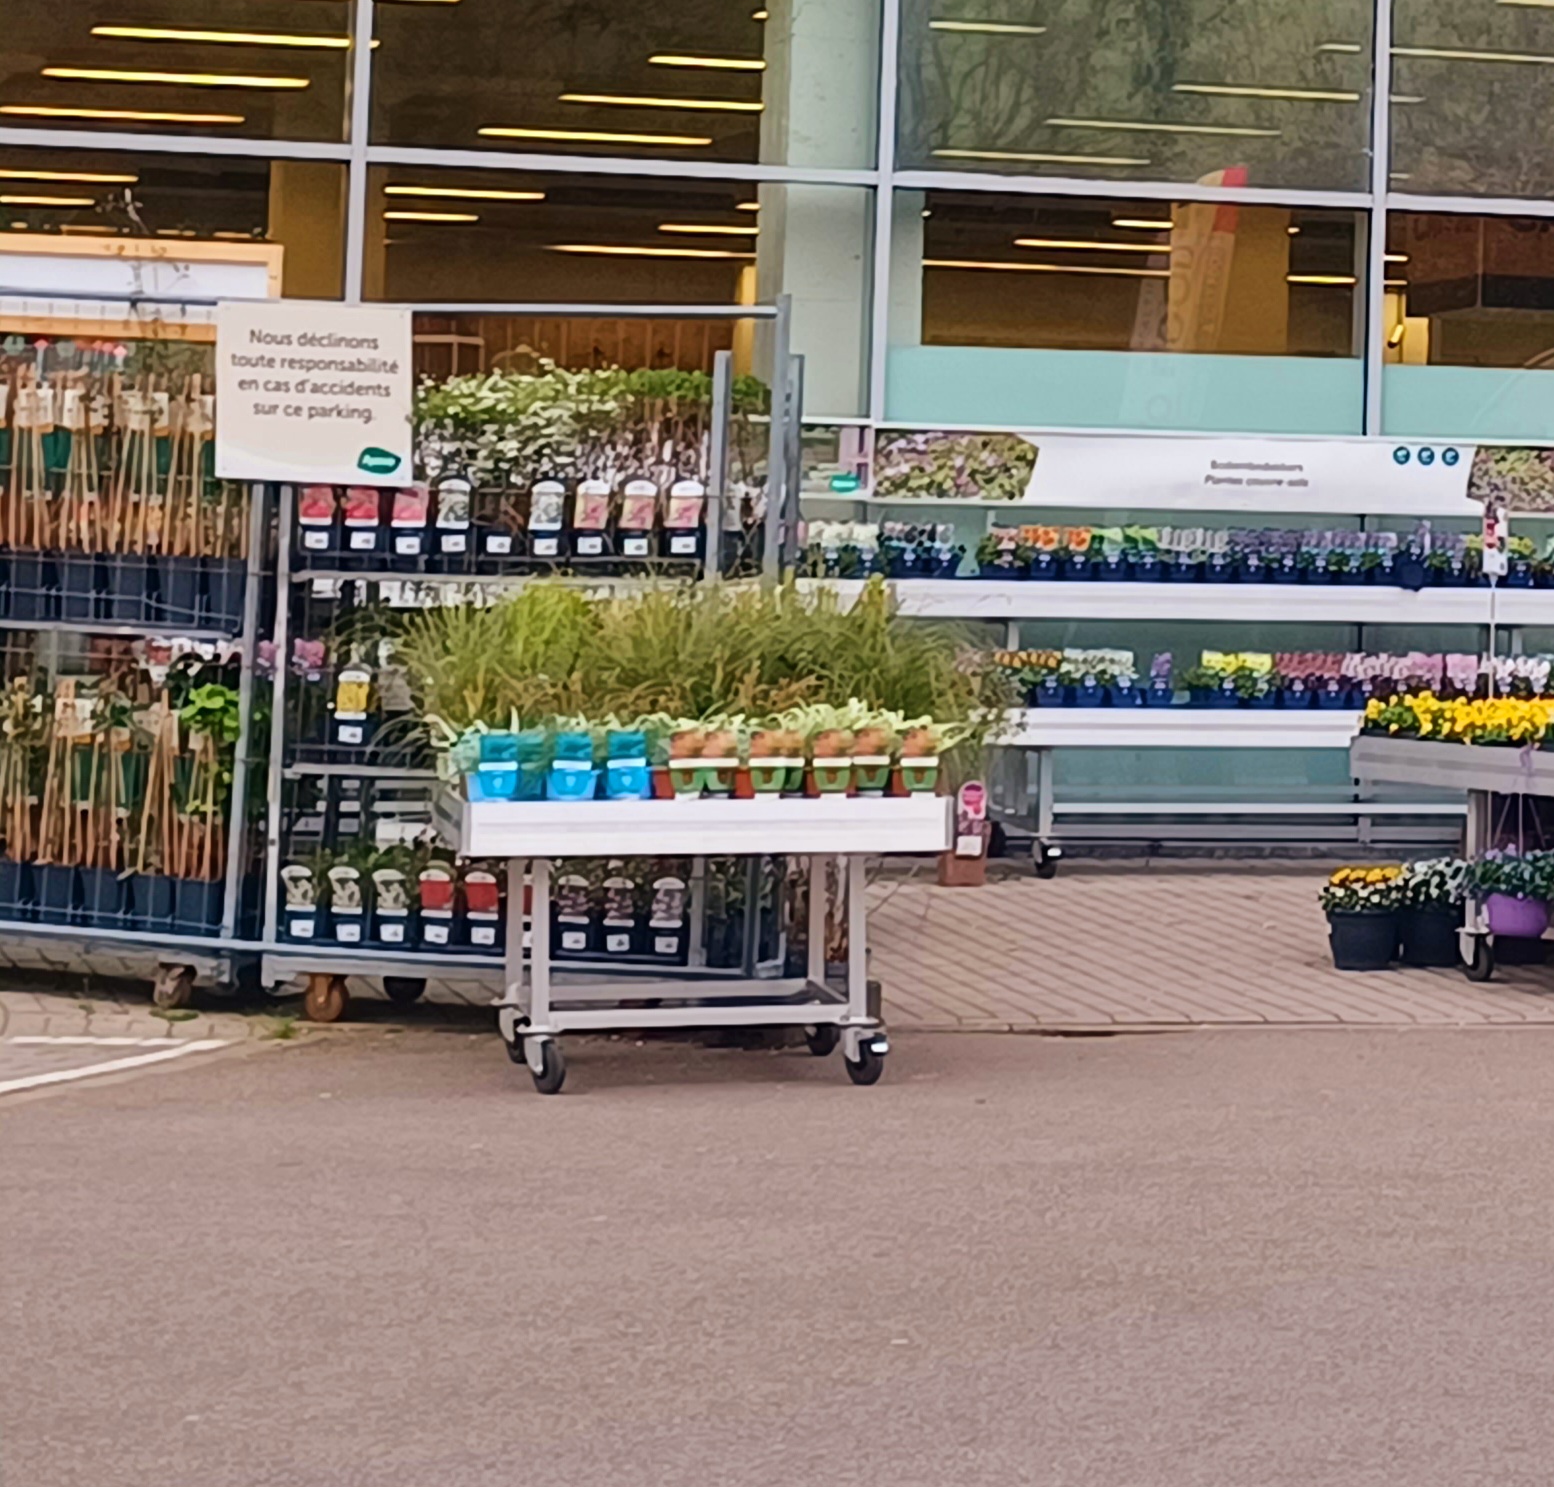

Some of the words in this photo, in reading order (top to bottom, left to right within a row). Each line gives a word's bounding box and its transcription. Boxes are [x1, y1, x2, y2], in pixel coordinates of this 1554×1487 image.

[249, 329, 293, 347] Nous
[297, 332, 379, 350] déclinons
[231, 353, 276, 368] toute
[280, 357, 399, 374] responsabilité
[238, 378, 259, 391] en
[263, 380, 290, 393] cas
[253, 402, 279, 415] sur
[283, 404, 303, 417] ce
